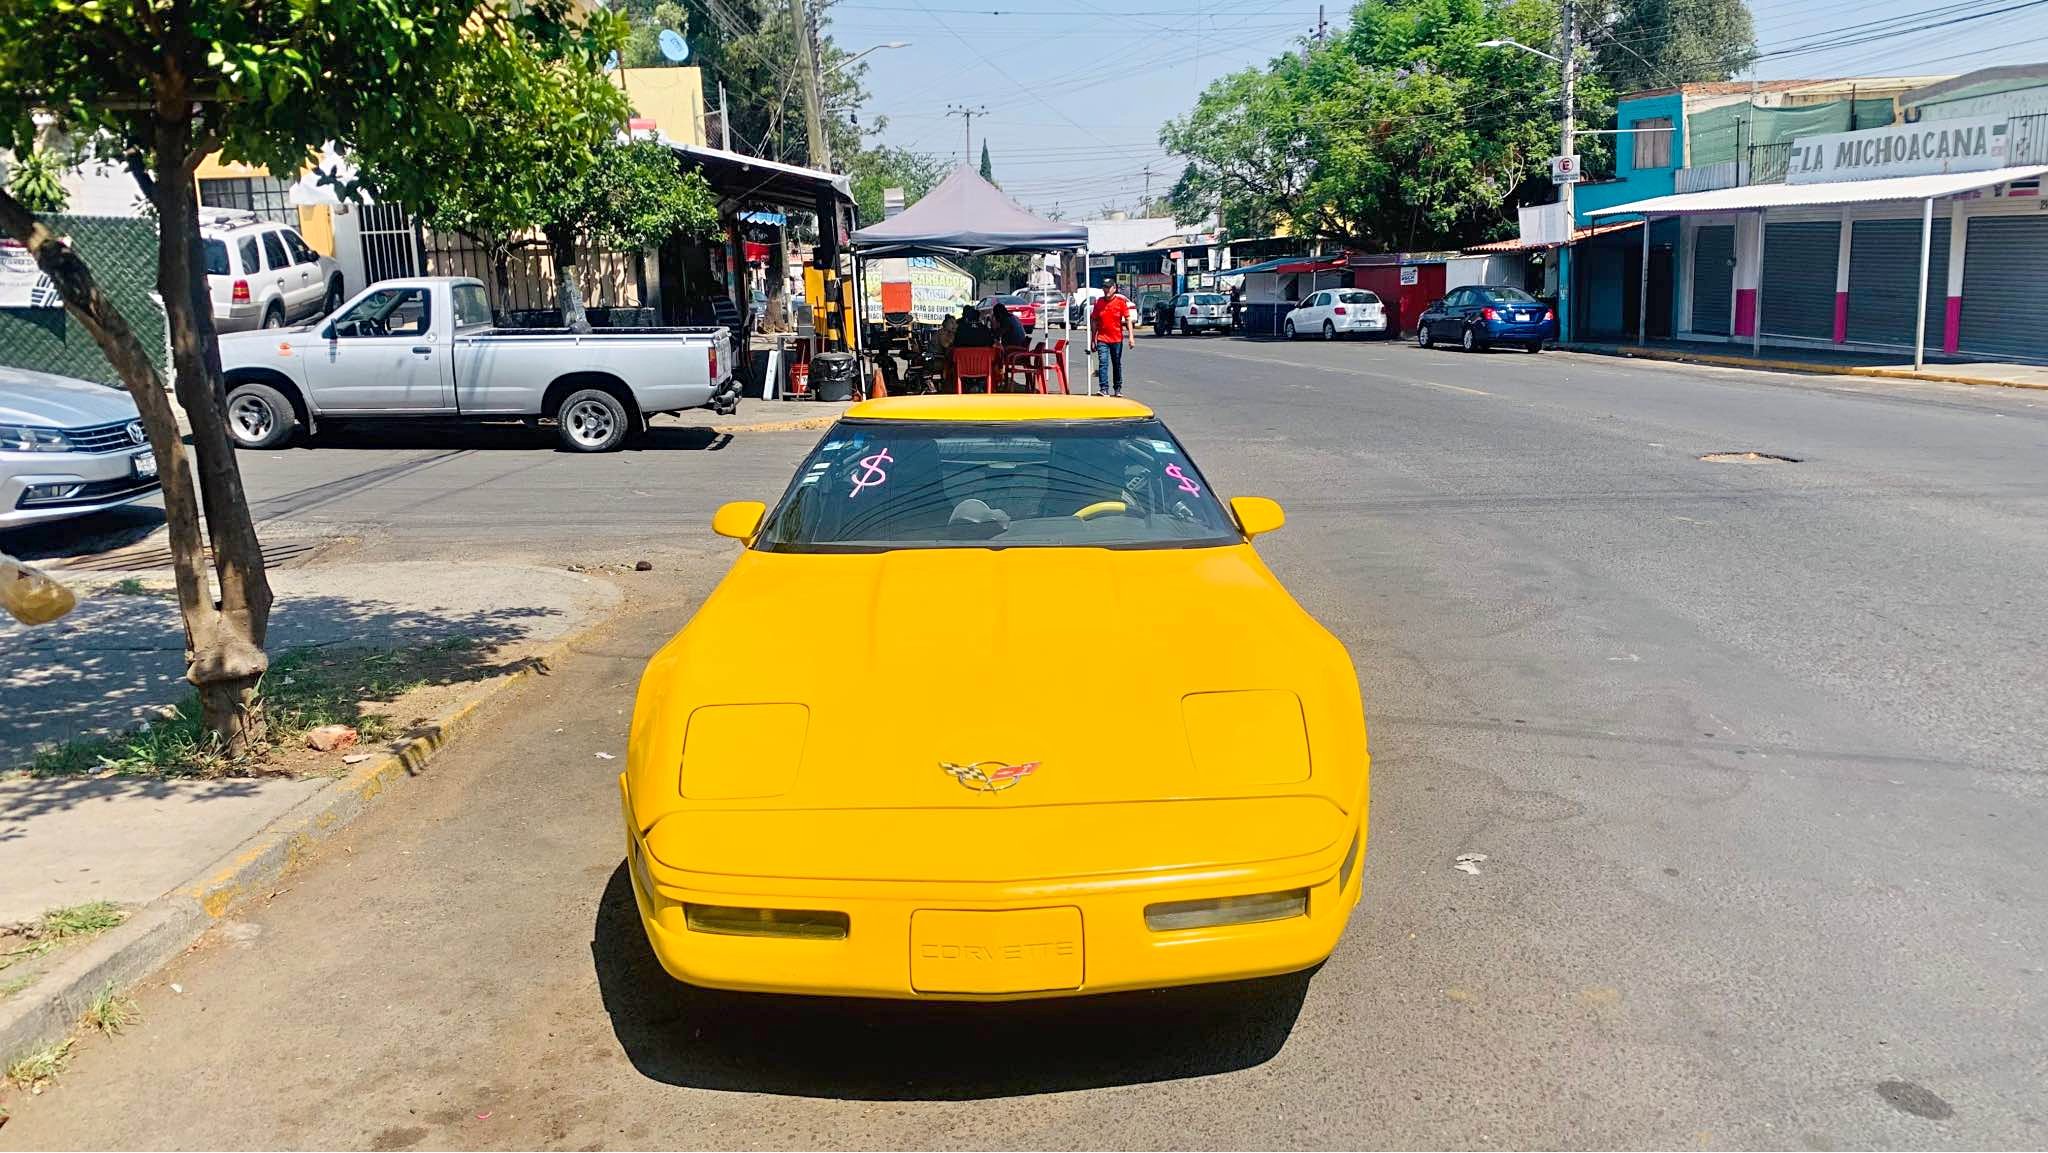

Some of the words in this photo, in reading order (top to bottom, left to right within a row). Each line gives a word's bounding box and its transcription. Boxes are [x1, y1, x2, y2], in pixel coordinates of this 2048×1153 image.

[1800, 143, 1824, 173] LA
[1833, 126, 1987, 170] MICHOACANA
[919, 940, 1073, 960] CORVETTE
